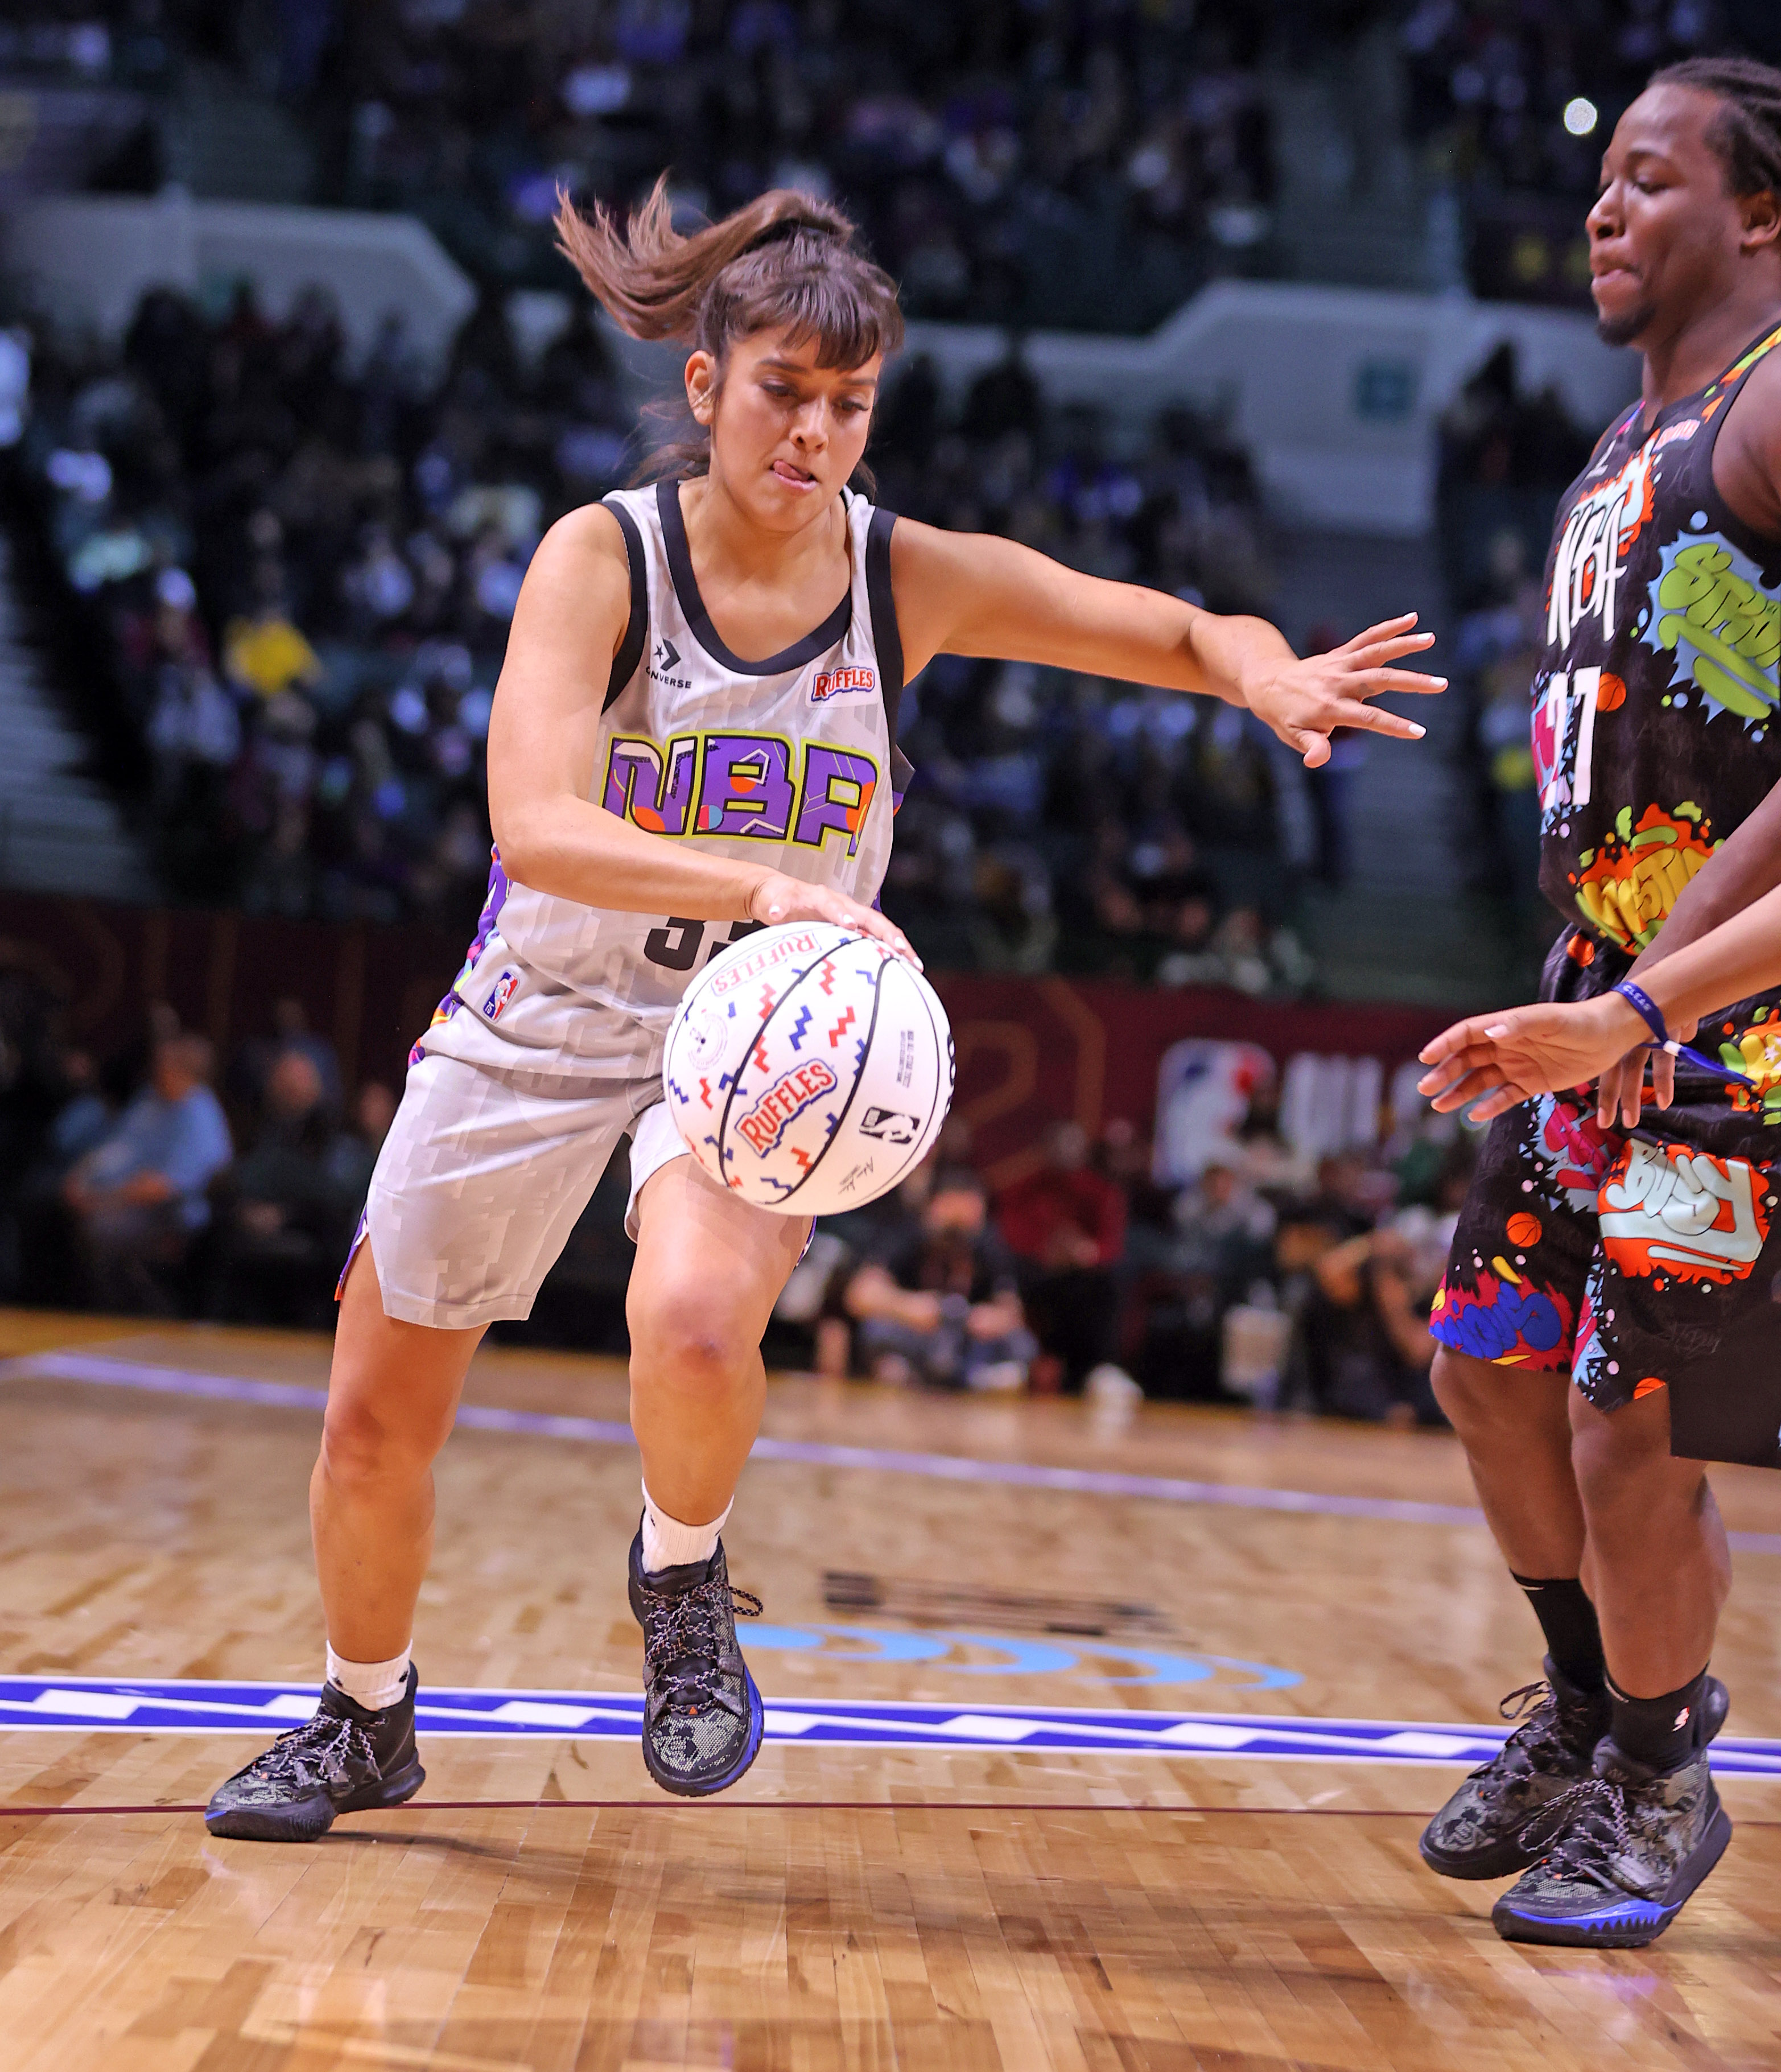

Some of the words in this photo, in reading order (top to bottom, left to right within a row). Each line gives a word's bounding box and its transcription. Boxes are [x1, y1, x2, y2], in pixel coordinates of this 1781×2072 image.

[645, 666, 692, 689] CNVERSE
[814, 668, 873, 697] RUFFLES
[601, 733, 880, 858] NBA
[644, 916, 770, 971] 3
[714, 934, 815, 992] RUFFLES
[740, 1064, 833, 1151] RUFFLES
